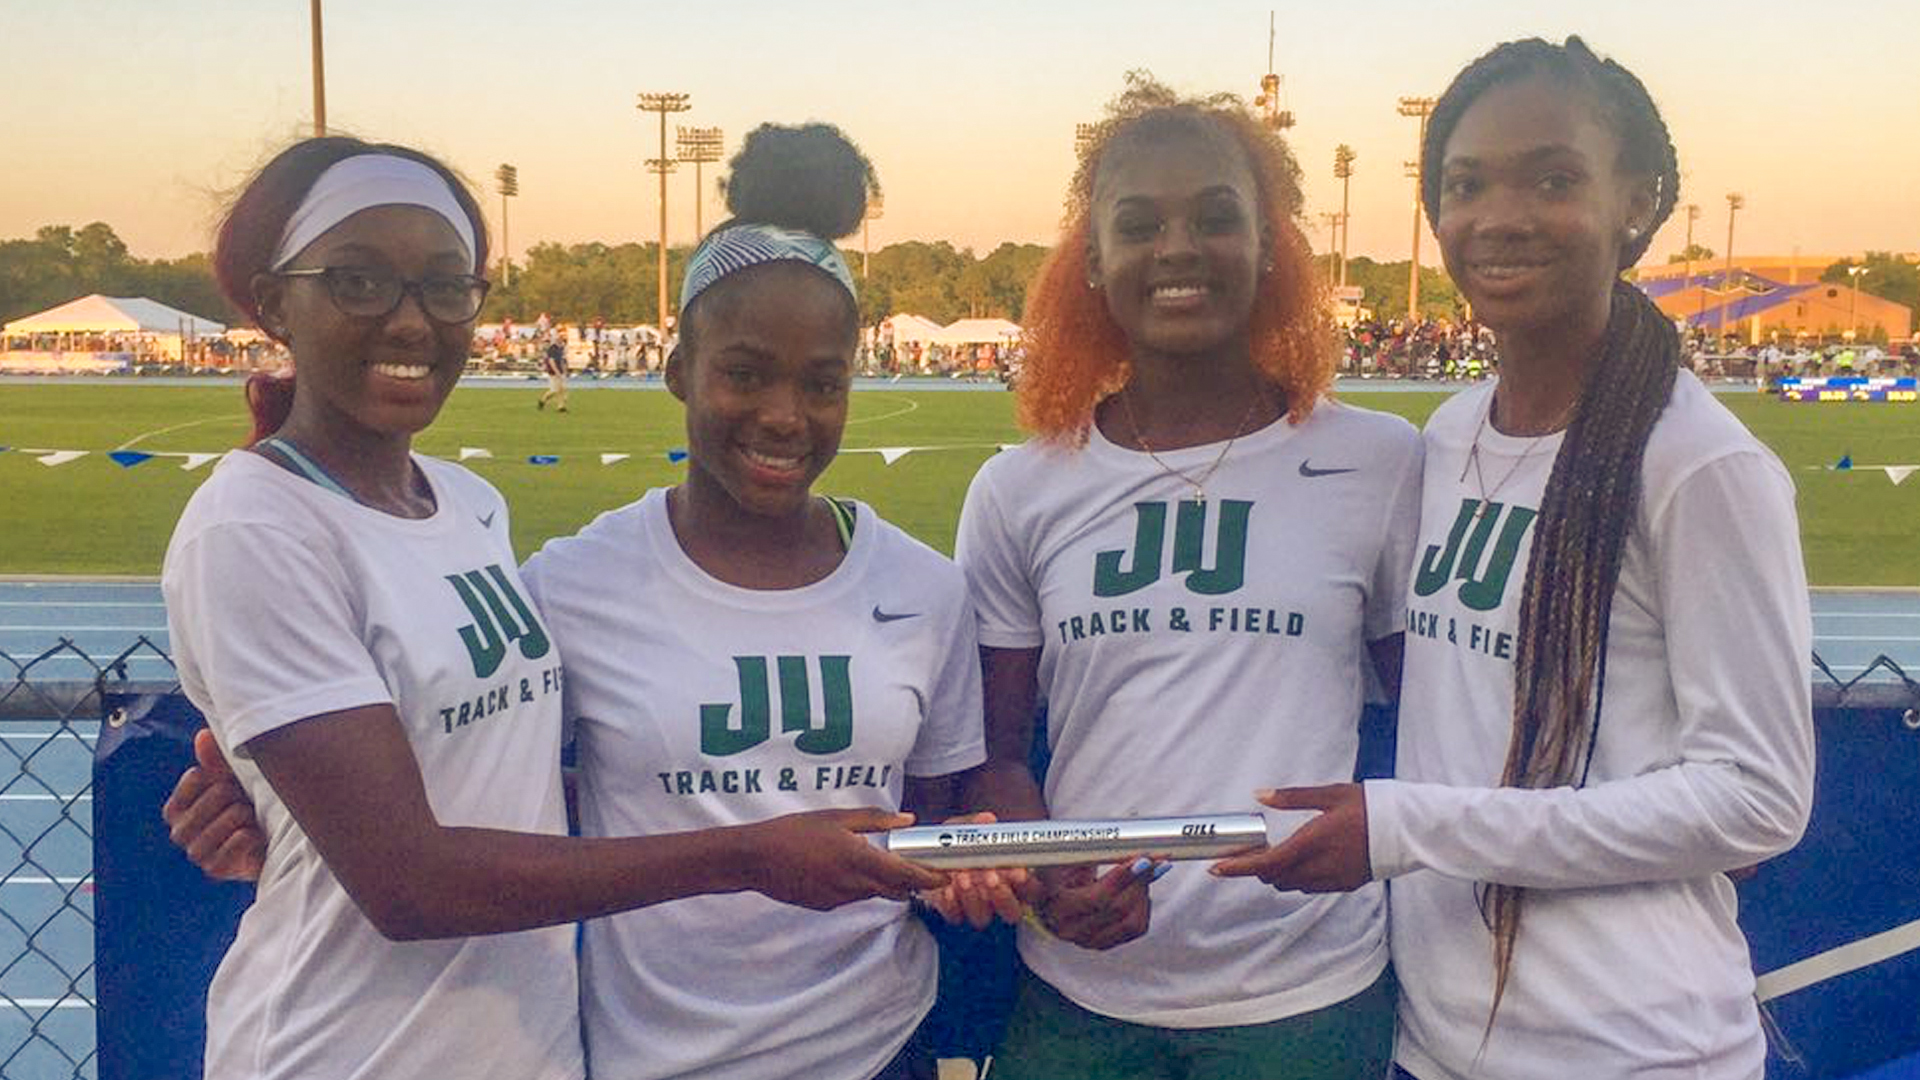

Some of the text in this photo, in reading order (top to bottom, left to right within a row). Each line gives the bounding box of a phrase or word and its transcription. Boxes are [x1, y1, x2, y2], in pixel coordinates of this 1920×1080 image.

[1094, 499, 1256, 598] JU
[1414, 498, 1539, 611] JU
[443, 564, 551, 678] JU
[1058, 607, 1304, 644] TRACK & FIELD
[1406, 607, 1512, 659] ACK & FIE
[439, 685, 509, 734] TRACK
[520, 678, 535, 703] &
[699, 655, 853, 757] JU
[657, 768, 762, 795] TRACK
[778, 767, 798, 792] &
[956, 832, 989, 845] TRACK
[1001, 831, 1029, 844] FIELD
[1032, 827, 1120, 842] CHAMPIONSHIPS
[1181, 823, 1218, 837] GILL
